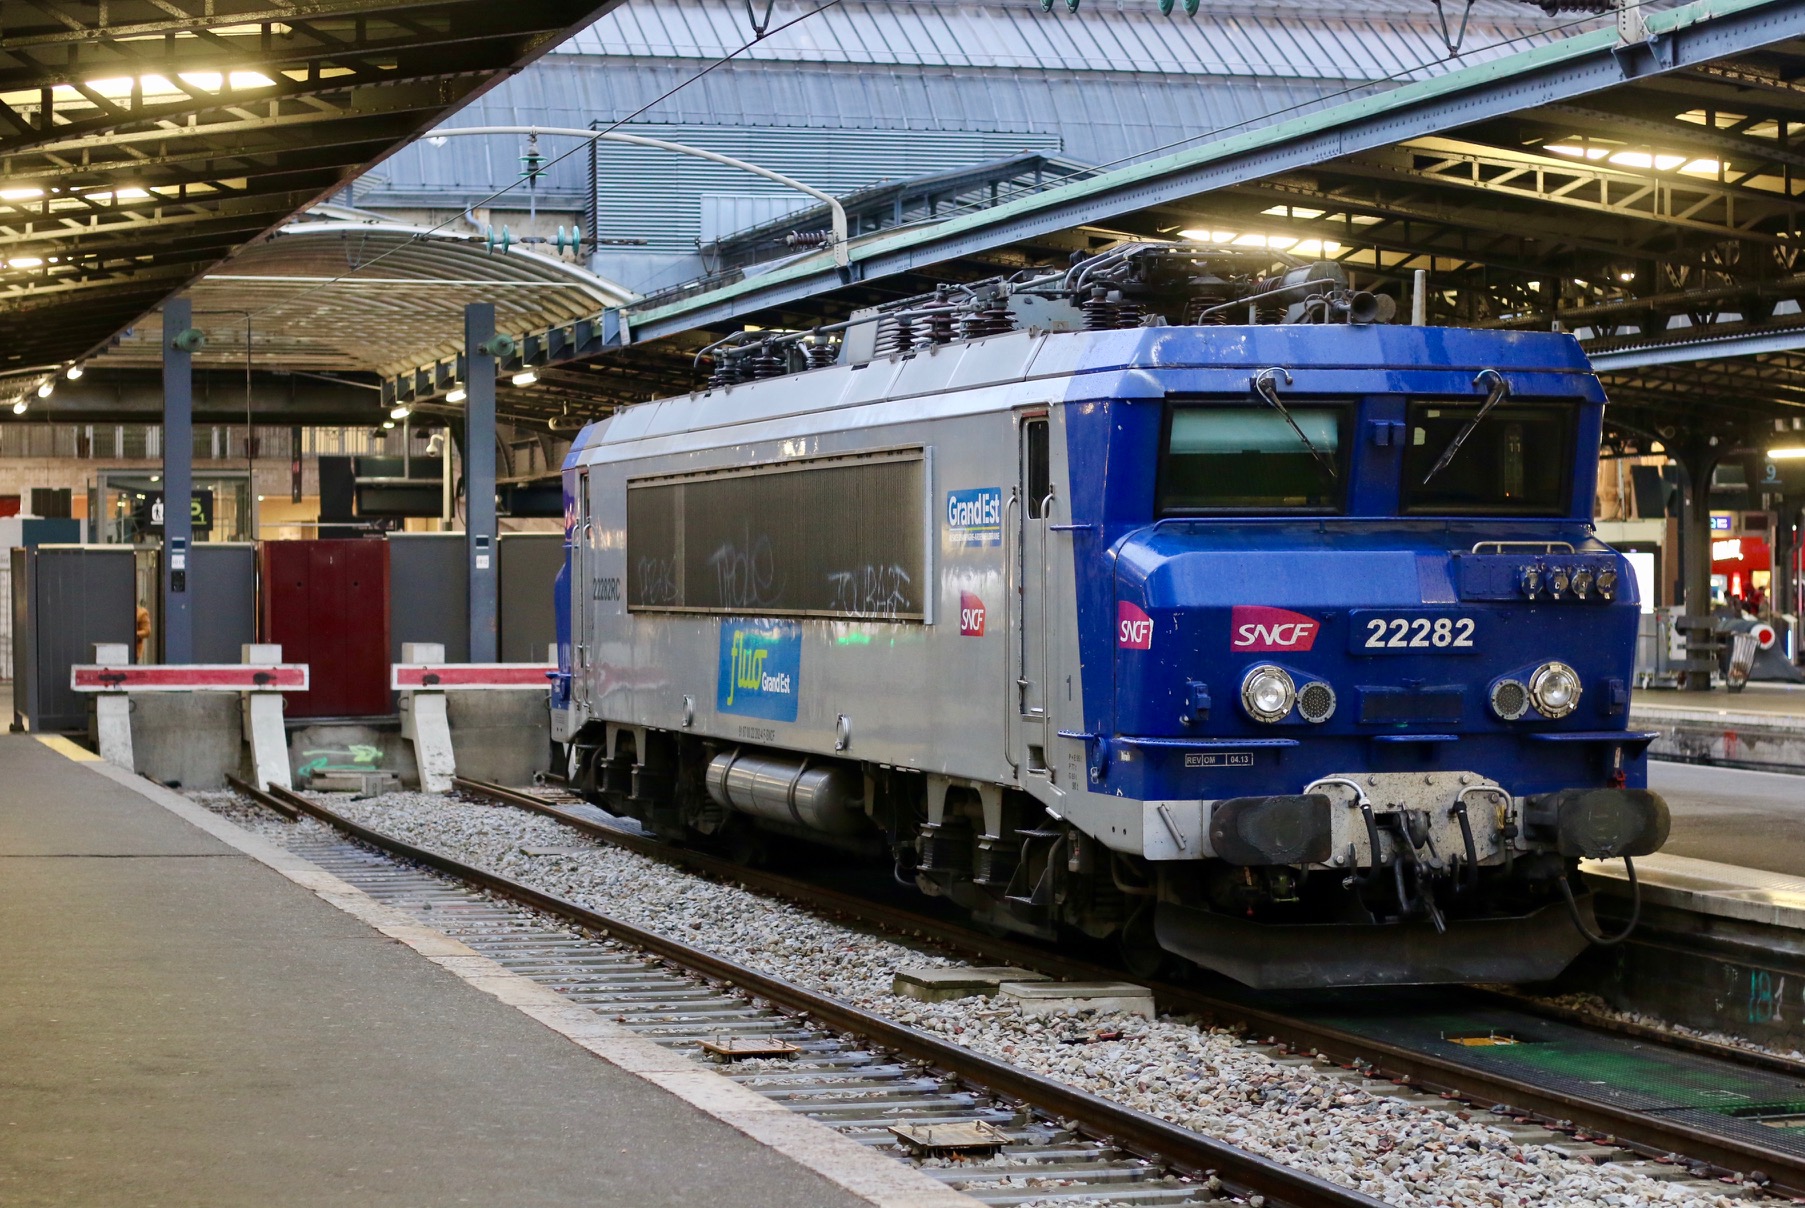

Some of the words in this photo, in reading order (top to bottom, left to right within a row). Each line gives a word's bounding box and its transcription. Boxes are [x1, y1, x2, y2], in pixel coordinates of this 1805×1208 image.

[961, 608, 984, 631] SNCF
[1120, 620, 1150, 643] SNCF
[1234, 623, 1314, 646] SNCF
[1364, 618, 1475, 648] 22282
[726, 629, 768, 706] fluo
[1066, 674, 1072, 702] 1
[1186, 756, 1202, 764] REV
[1230, 755, 1249, 763] 04.13
